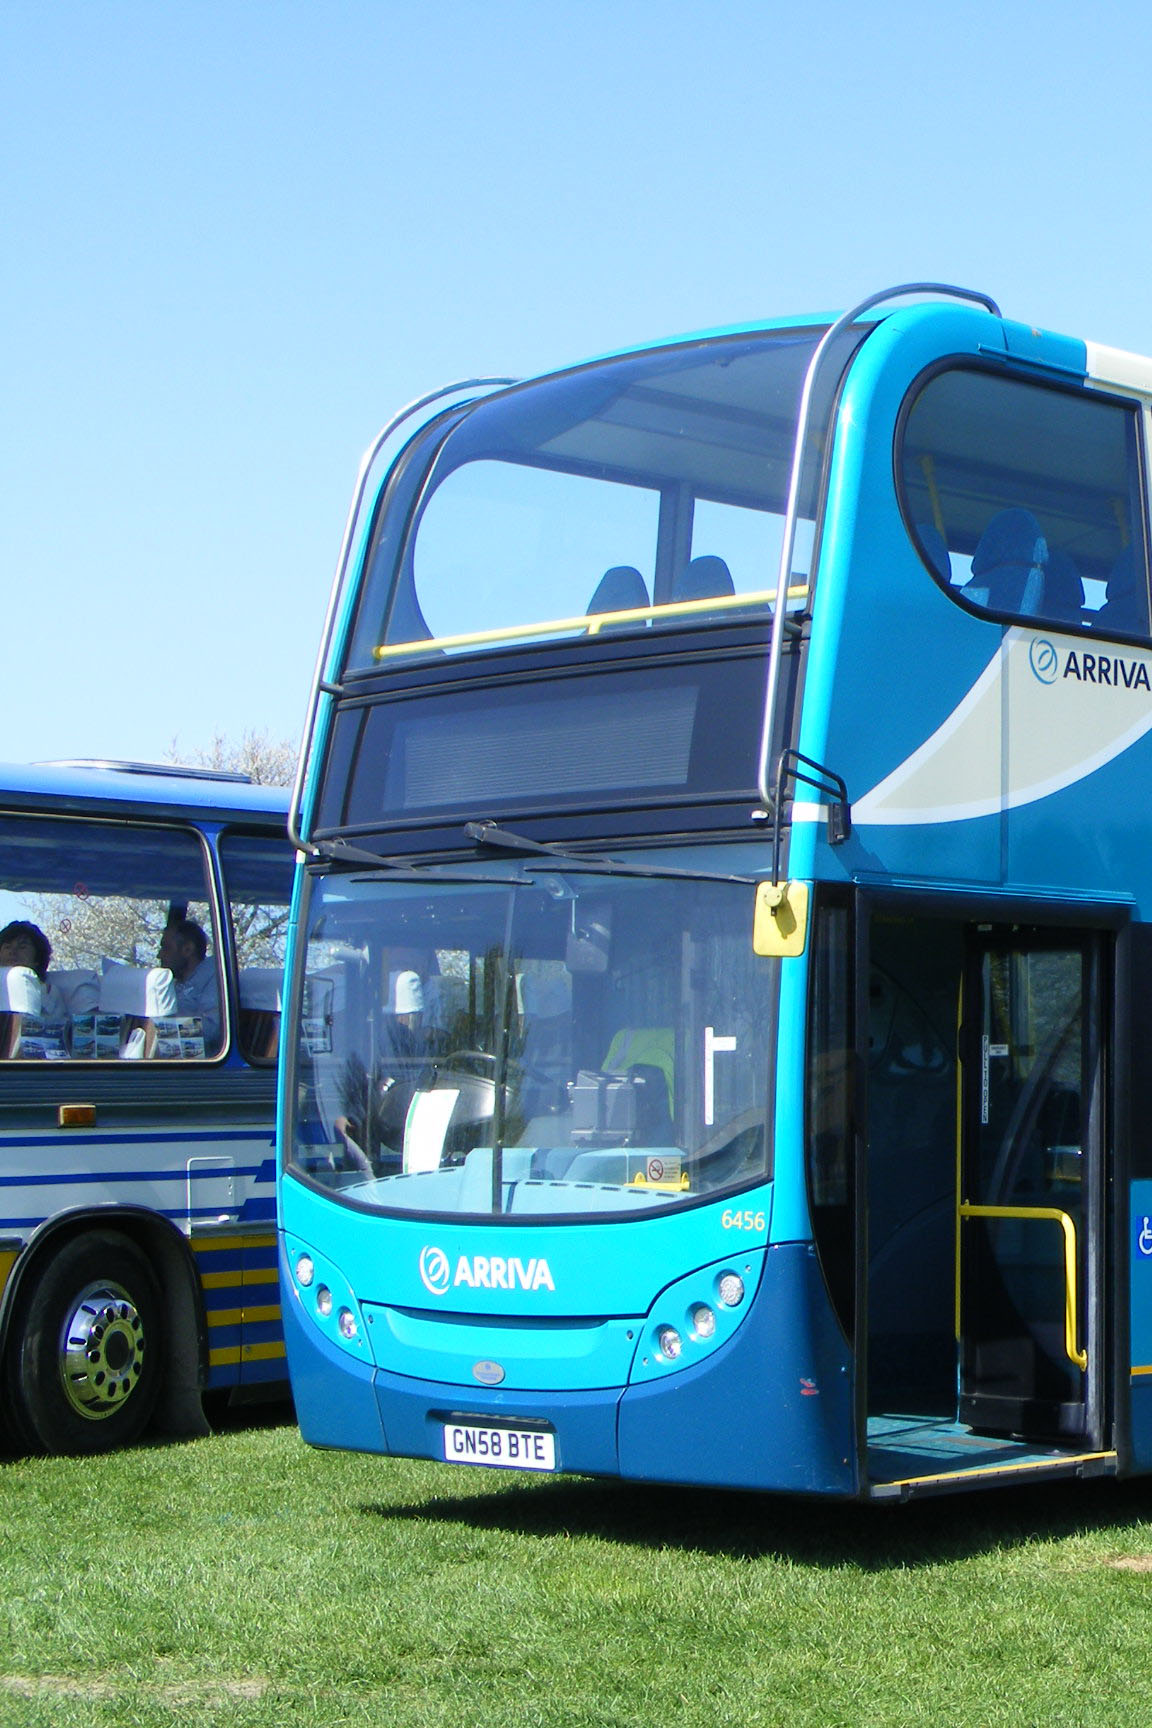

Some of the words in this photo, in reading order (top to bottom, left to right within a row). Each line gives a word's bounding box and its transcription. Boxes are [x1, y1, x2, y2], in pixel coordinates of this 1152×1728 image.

[1063, 651, 1151, 692] ARRIVA
[721, 1209, 766, 1231] 6456
[453, 1255, 556, 1291] ARRIVA
[453, 1428, 502, 1457] GN58
[507, 1432, 546, 1461] BTE
